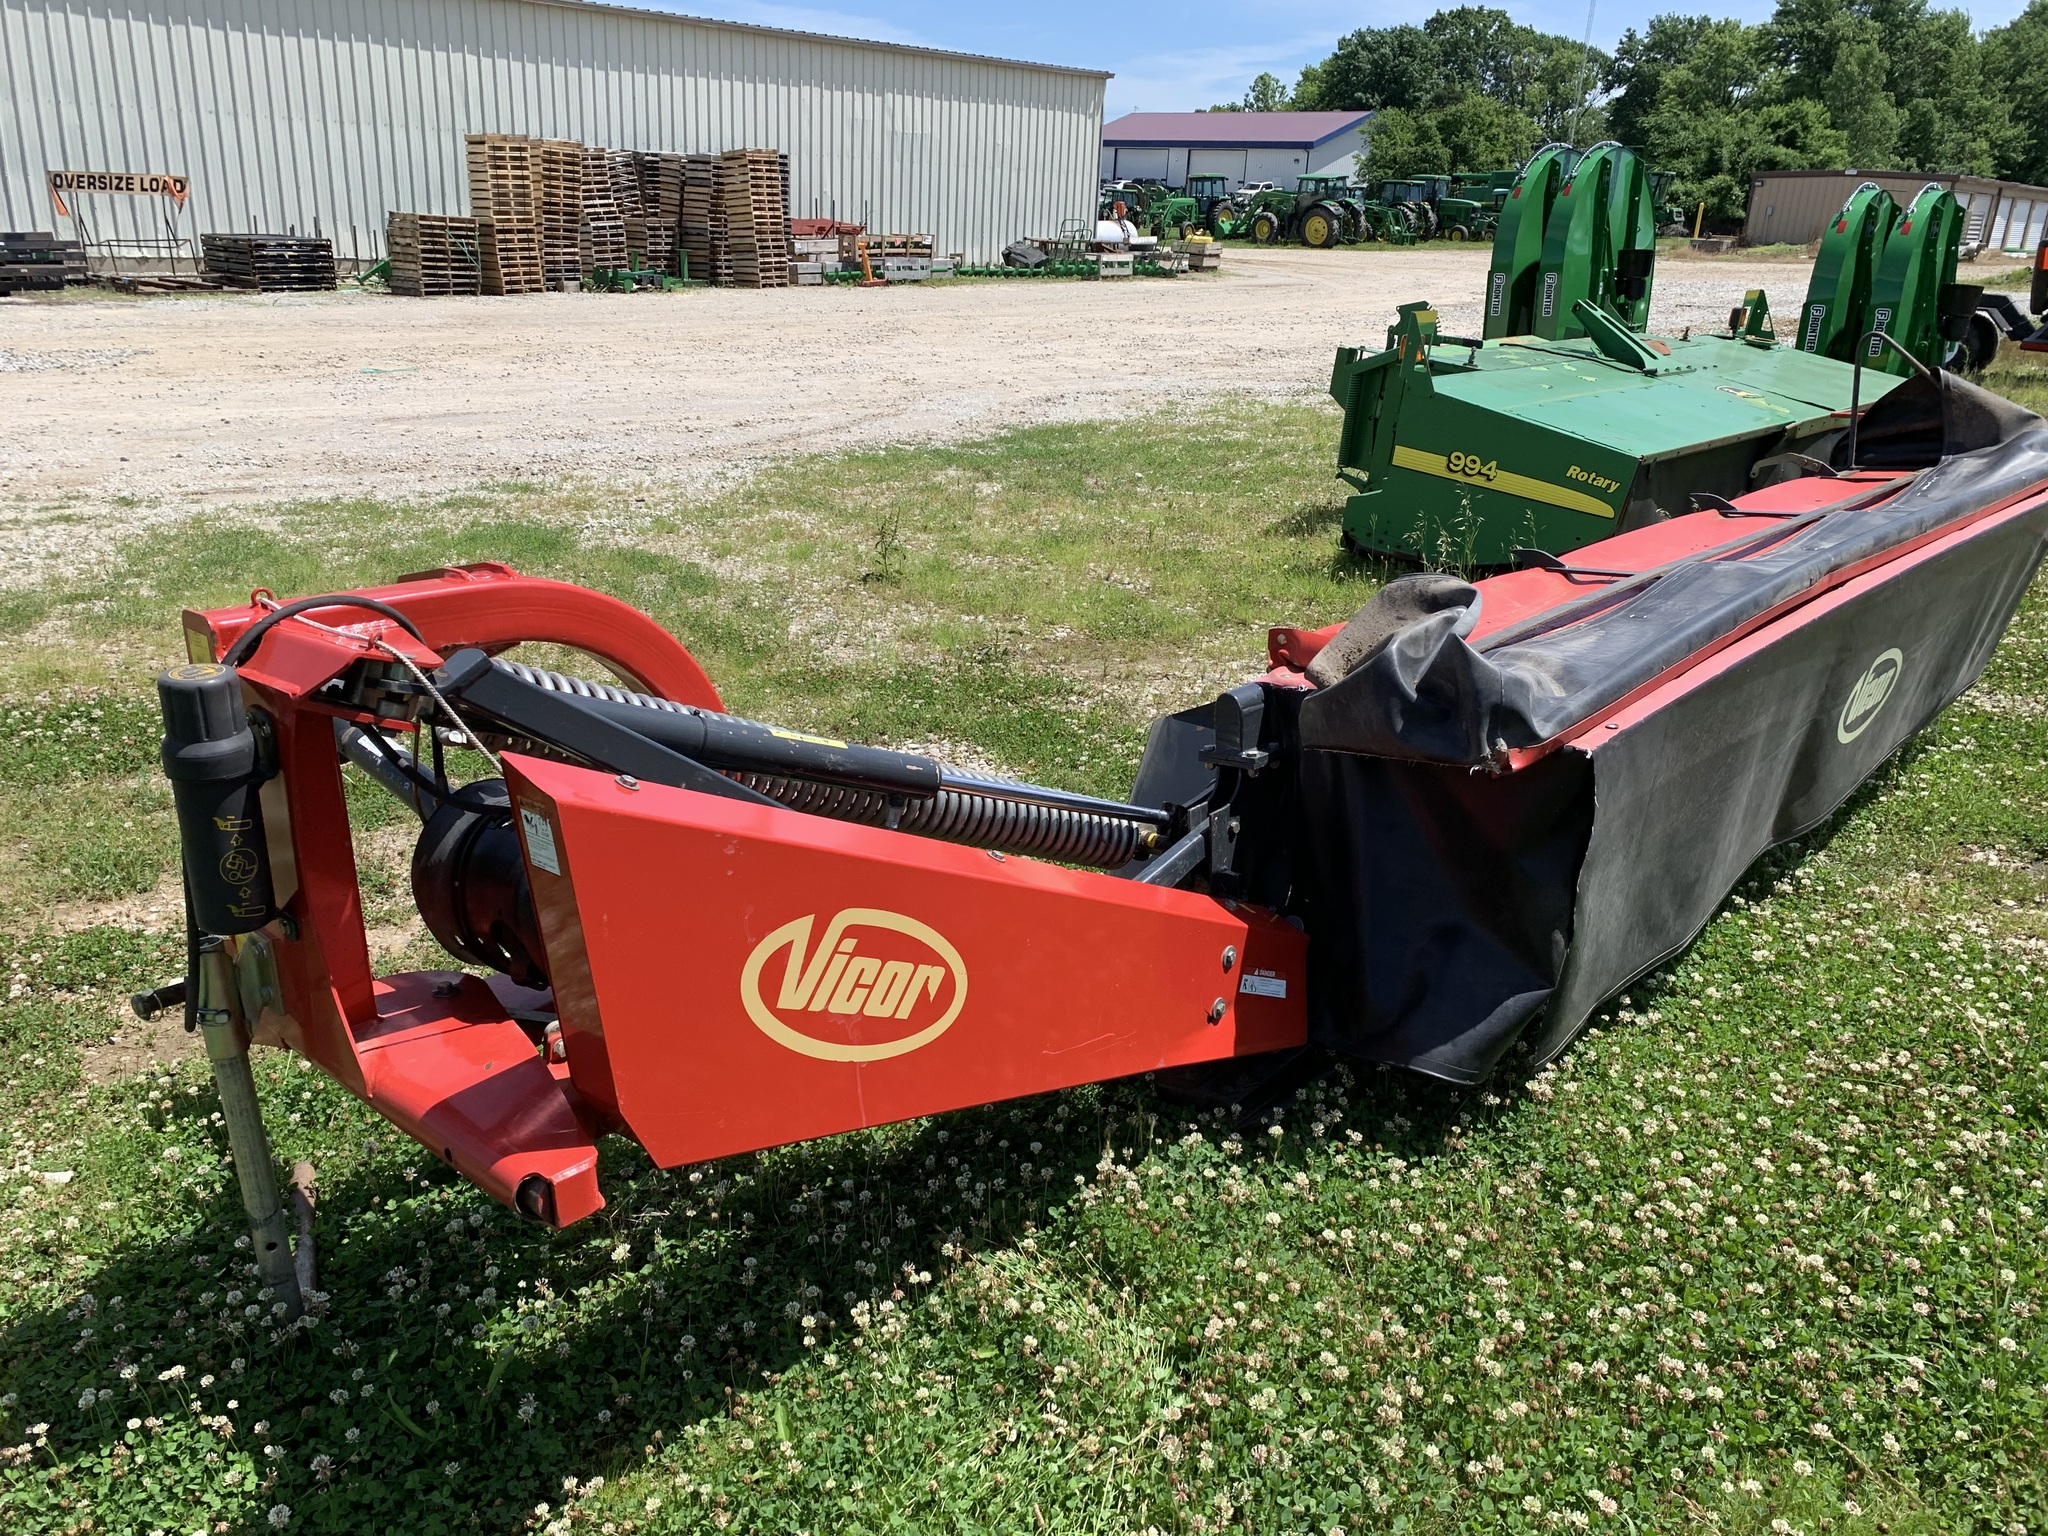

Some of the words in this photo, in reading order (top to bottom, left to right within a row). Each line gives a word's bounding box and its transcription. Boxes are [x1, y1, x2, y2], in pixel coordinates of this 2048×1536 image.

[52, 173, 135, 192] OVERSIZE
[140, 176, 187, 194] LOAD
[1491, 273, 1505, 316] FRONTIER
[1542, 273, 1557, 316] FRONTIER
[1805, 304, 1825, 352] FRONTIER
[1869, 308, 1891, 356] FROTIER
[1448, 451, 1498, 482] 994
[1566, 465, 1622, 493] Rotary
[1843, 666, 1898, 728] Vicor
[775, 912, 947, 1021] Vicor
